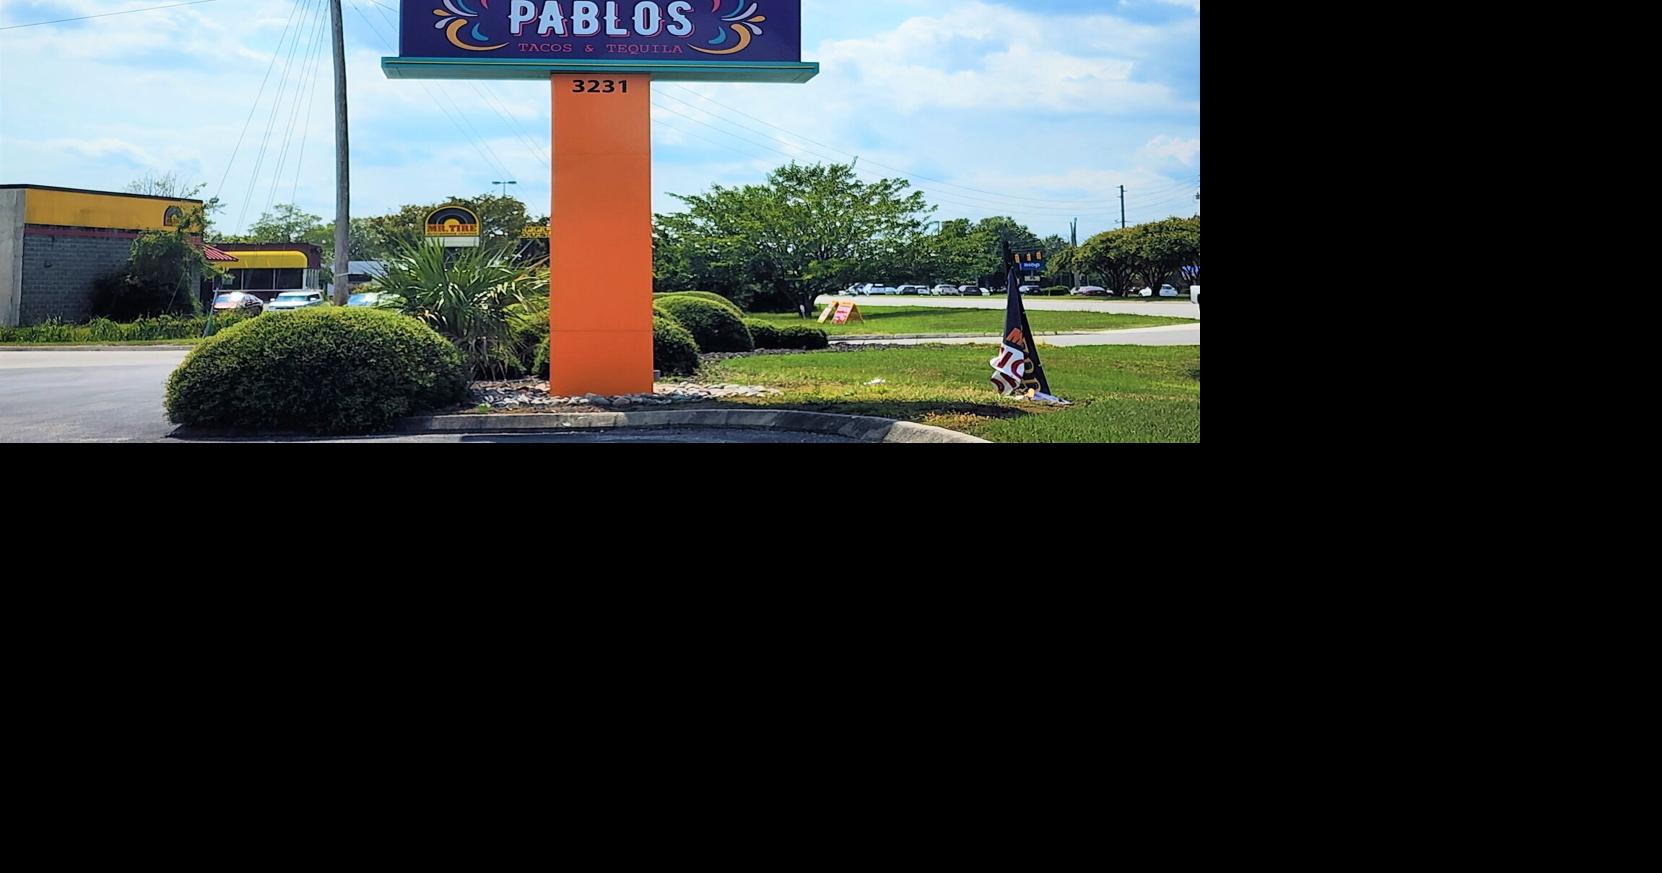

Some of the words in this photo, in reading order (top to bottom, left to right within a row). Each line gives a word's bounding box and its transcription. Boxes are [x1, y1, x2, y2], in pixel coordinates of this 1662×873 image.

[508, 0, 695, 37] PABLOS
[518, 43, 573, 52] TACOS
[584, 43, 594, 53] &
[606, 44, 683, 54] TEQUILA
[572, 79, 627, 93] 3231
[449, 224, 477, 232] TIRE
